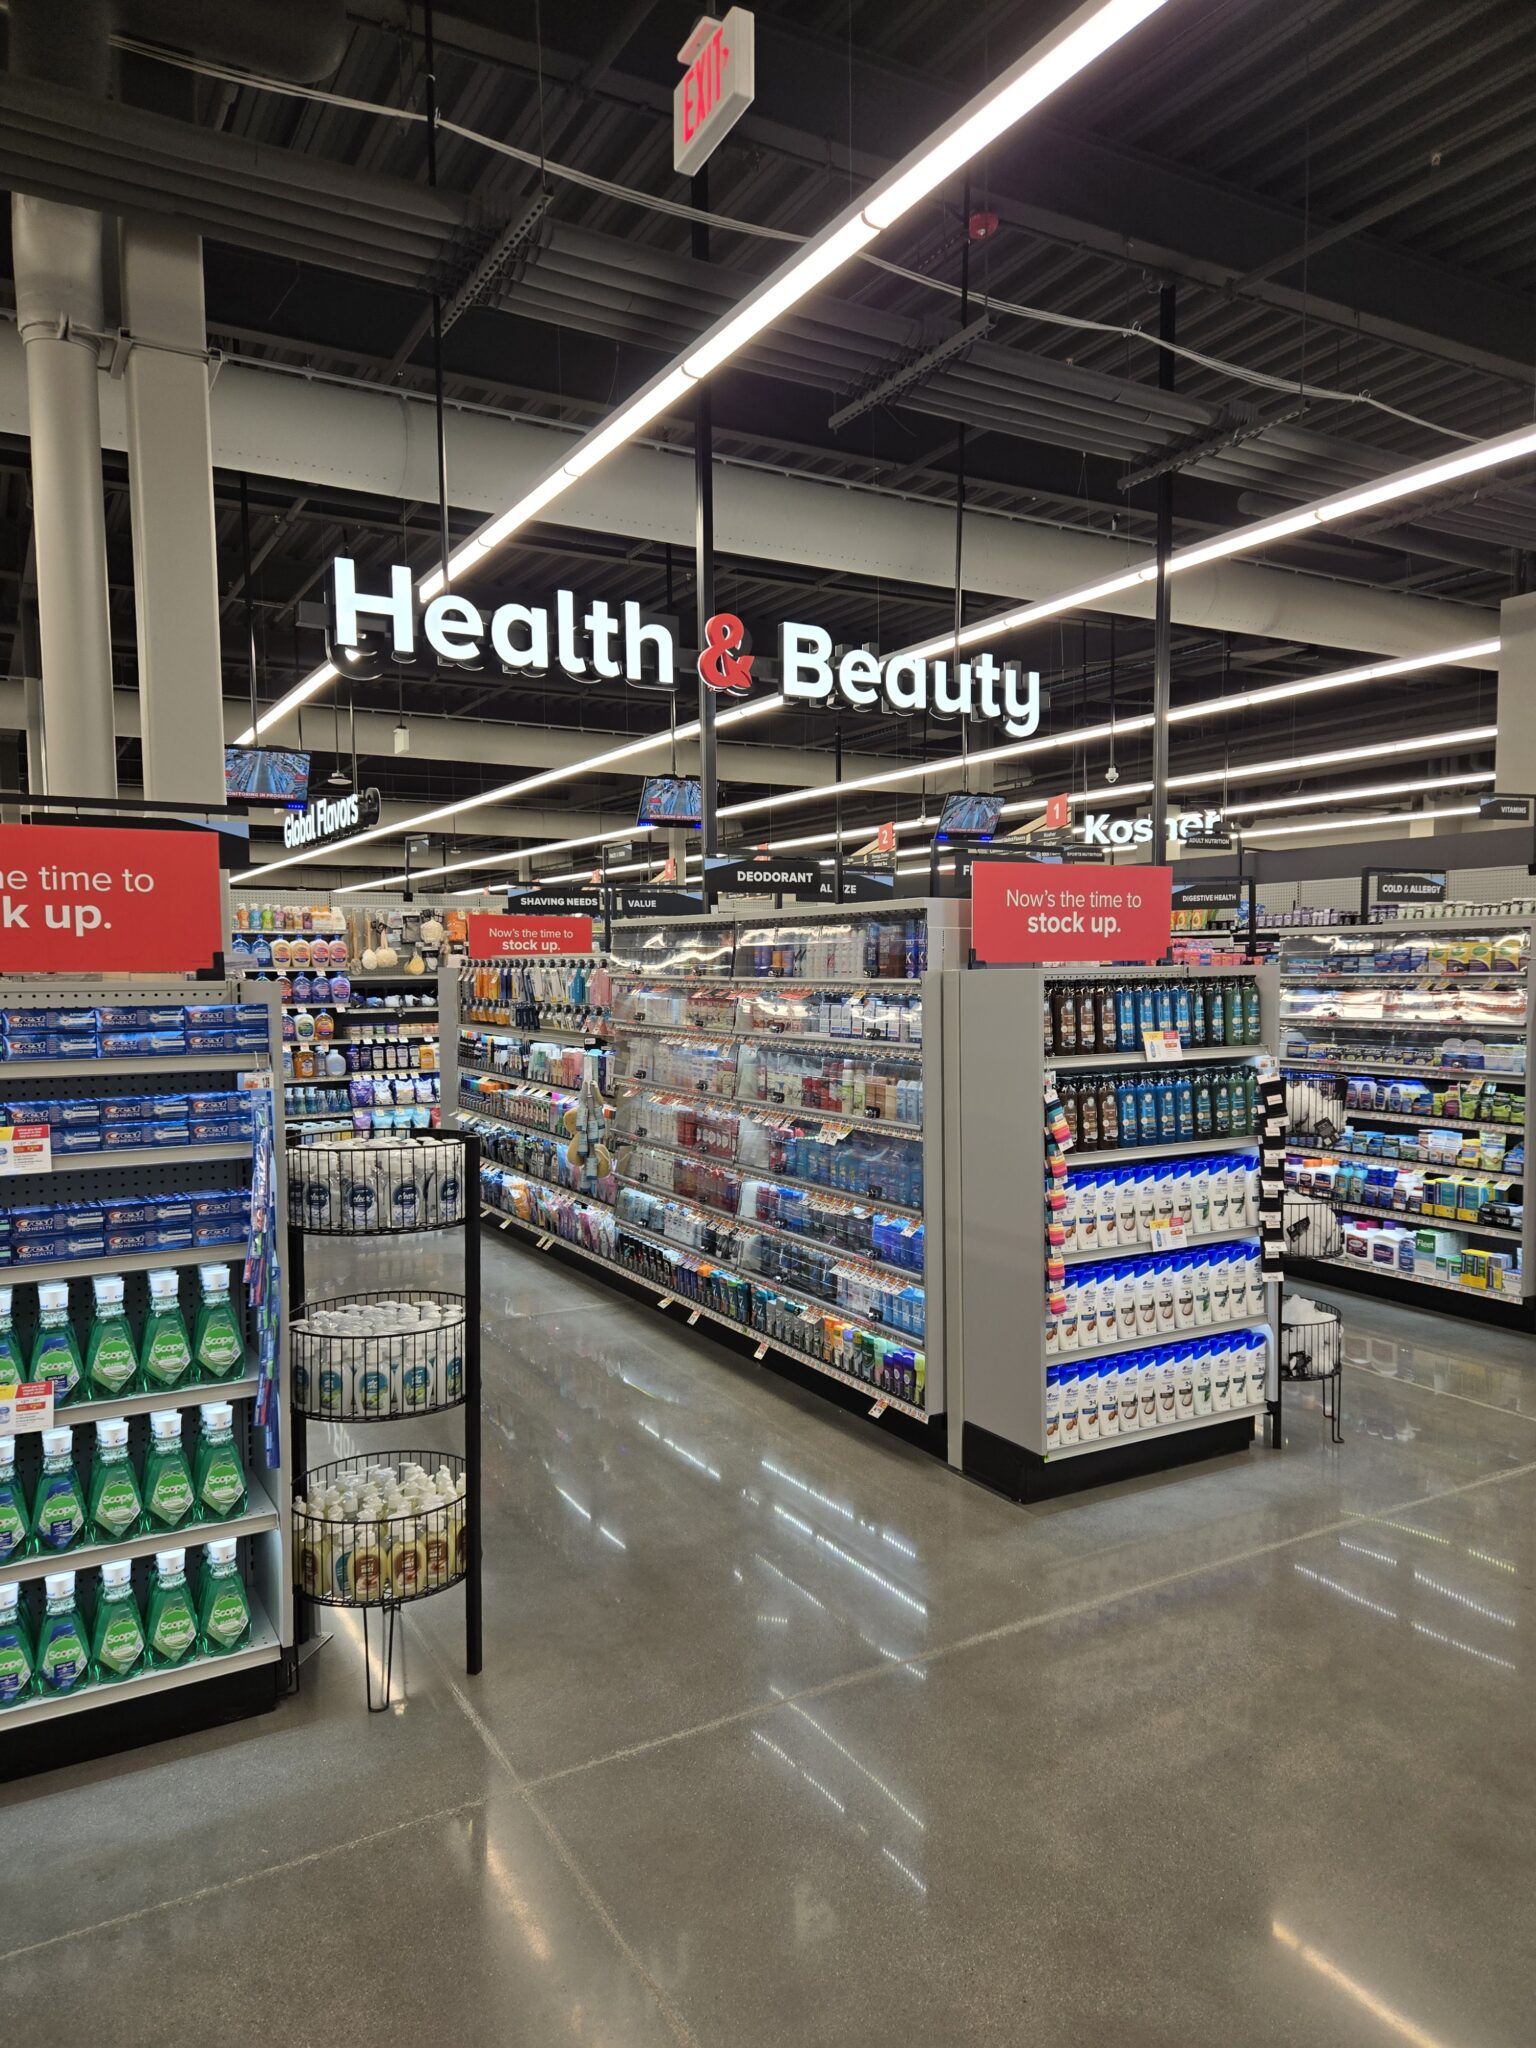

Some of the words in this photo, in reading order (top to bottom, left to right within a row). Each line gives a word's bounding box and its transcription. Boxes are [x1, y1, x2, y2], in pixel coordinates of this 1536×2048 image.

[683, 26, 724, 144] EXIT
[334, 557, 674, 684] Health
[698, 613, 754, 690] &
[782, 621, 1040, 738] Beauty
[1053, 803, 1059, 819] 1
[1501, 806, 1527, 814] VITAMINS
[284, 810, 315, 848] Global
[317, 794, 358, 836] Flavors
[882, 830, 888, 844] 2
[38, 865, 112, 892] time
[121, 868, 155, 893] to
[737, 871, 814, 883] DEODORANT
[1382, 884, 1403, 893] COLD
[1403, 885, 1408, 894] &
[1410, 885, 1441, 894] ALLERGY
[520, 897, 565, 906] SHAVING
[567, 897, 598, 907] NEEDS
[628, 899, 657, 908] VALUE
[1060, 890, 1085, 908] the
[1089, 891, 1123, 908] time
[1127, 894, 1142, 908] to
[1182, 894, 1213, 902] DIGESTIVE
[1214, 893, 1237, 901] HEALTH
[44, 903, 112, 937] up.
[1027, 911, 1085, 933] stock
[1091, 915, 1121, 938] up.
[521, 928, 538, 939] the
[539, 928, 562, 939] time
[563, 930, 573, 939] to
[502, 939, 537, 951] stock
[541, 941, 560, 953] up.
[1416, 1238, 1434, 1249] Fleet
[205, 1335, 234, 1347] Scope
[99, 1350, 130, 1360] Scope
[155, 1343, 184, 1354] Scope
[41, 1361, 73, 1372] Scope
[208, 1473, 238, 1485] Scope
[158, 1482, 188, 1495] Scope
[103, 1492, 134, 1505] Scope
[45, 1505, 78, 1518] Scope
[214, 1605, 243, 1619] Scope
[161, 1618, 189, 1631] Scope
[106, 1630, 137, 1644] Scope
[48, 1647, 80, 1660] Scope
